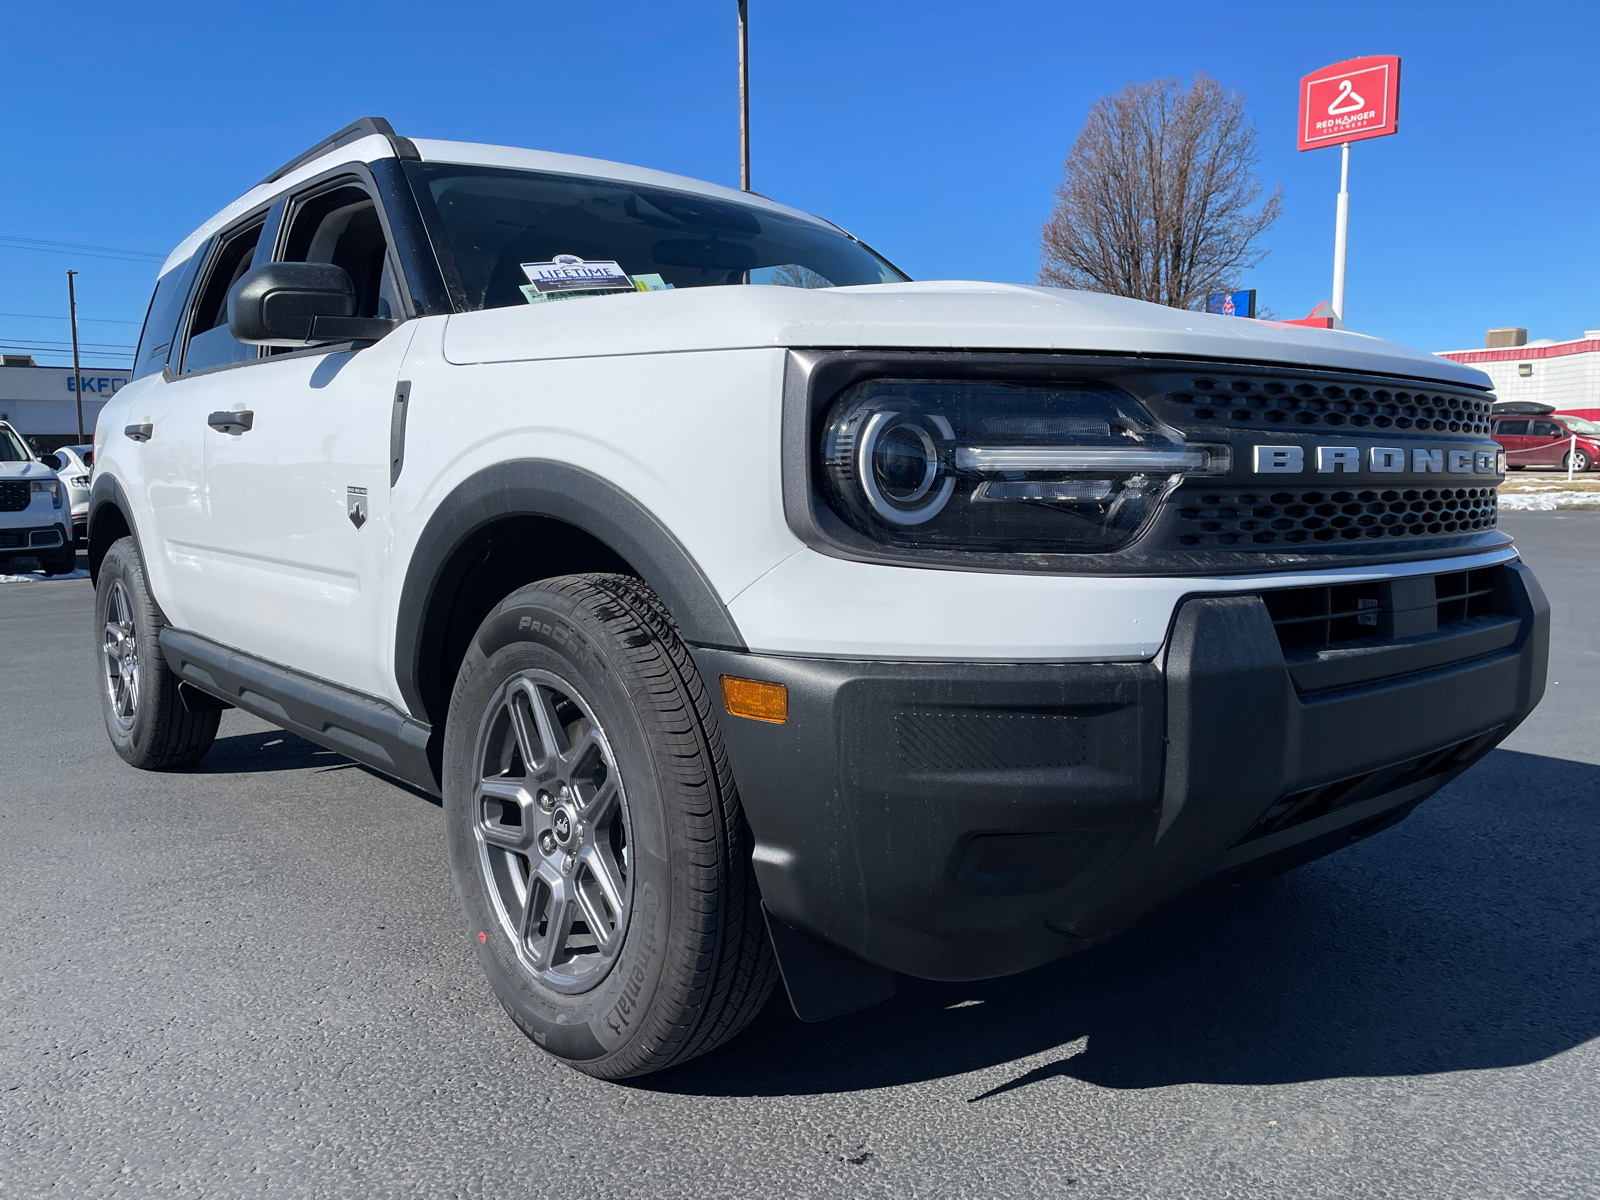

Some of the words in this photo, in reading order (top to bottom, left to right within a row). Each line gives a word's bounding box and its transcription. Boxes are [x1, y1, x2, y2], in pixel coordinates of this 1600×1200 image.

[1316, 119, 1334, 129] RED
[1335, 110, 1375, 125] HANGER
[1323, 120, 1367, 134] CLEANERS
[538, 268, 612, 279] LIFETIME
[1253, 445, 1494, 474] BRONCO
